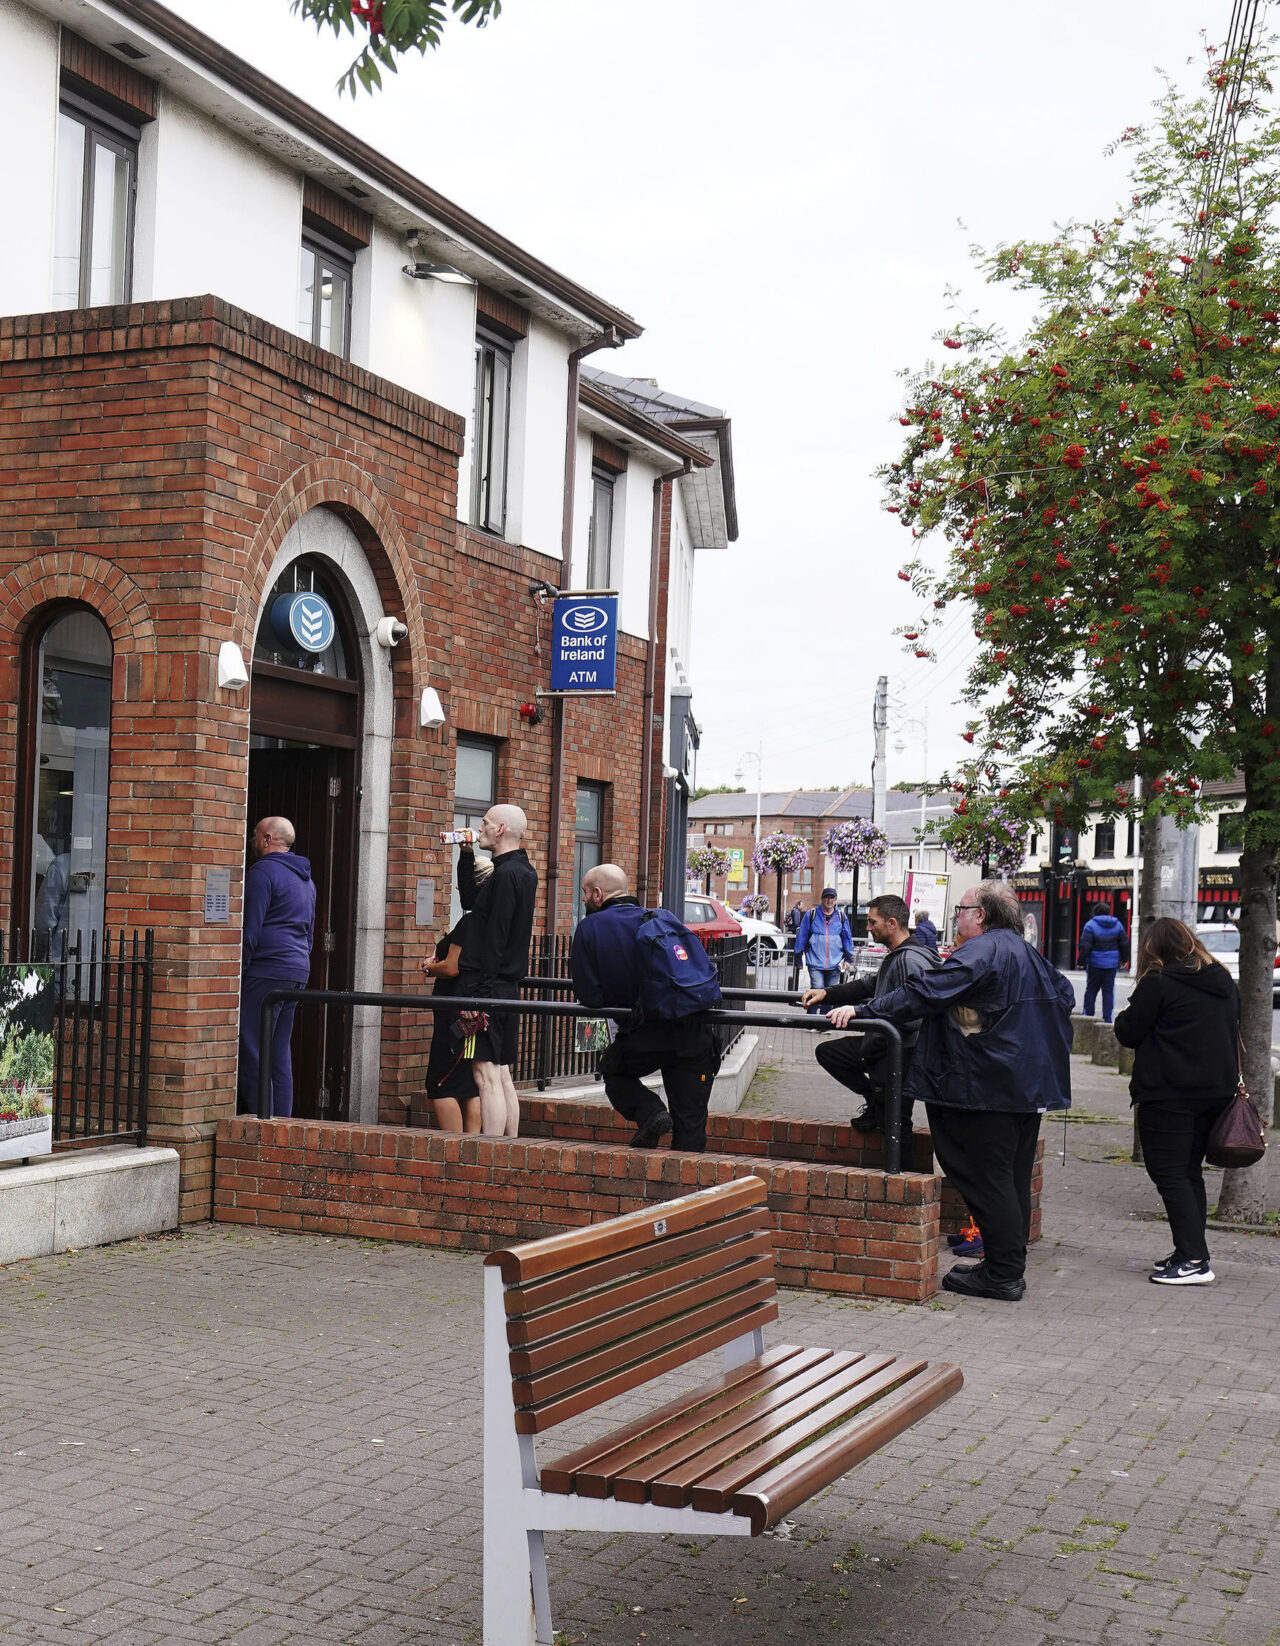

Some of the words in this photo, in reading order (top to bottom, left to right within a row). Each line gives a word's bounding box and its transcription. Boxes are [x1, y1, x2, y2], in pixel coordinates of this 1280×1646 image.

[561, 636, 592, 647] Bank
[594, 635, 607, 646] of
[561, 649, 604, 660] Ireland
[569, 671, 597, 683] ATM
